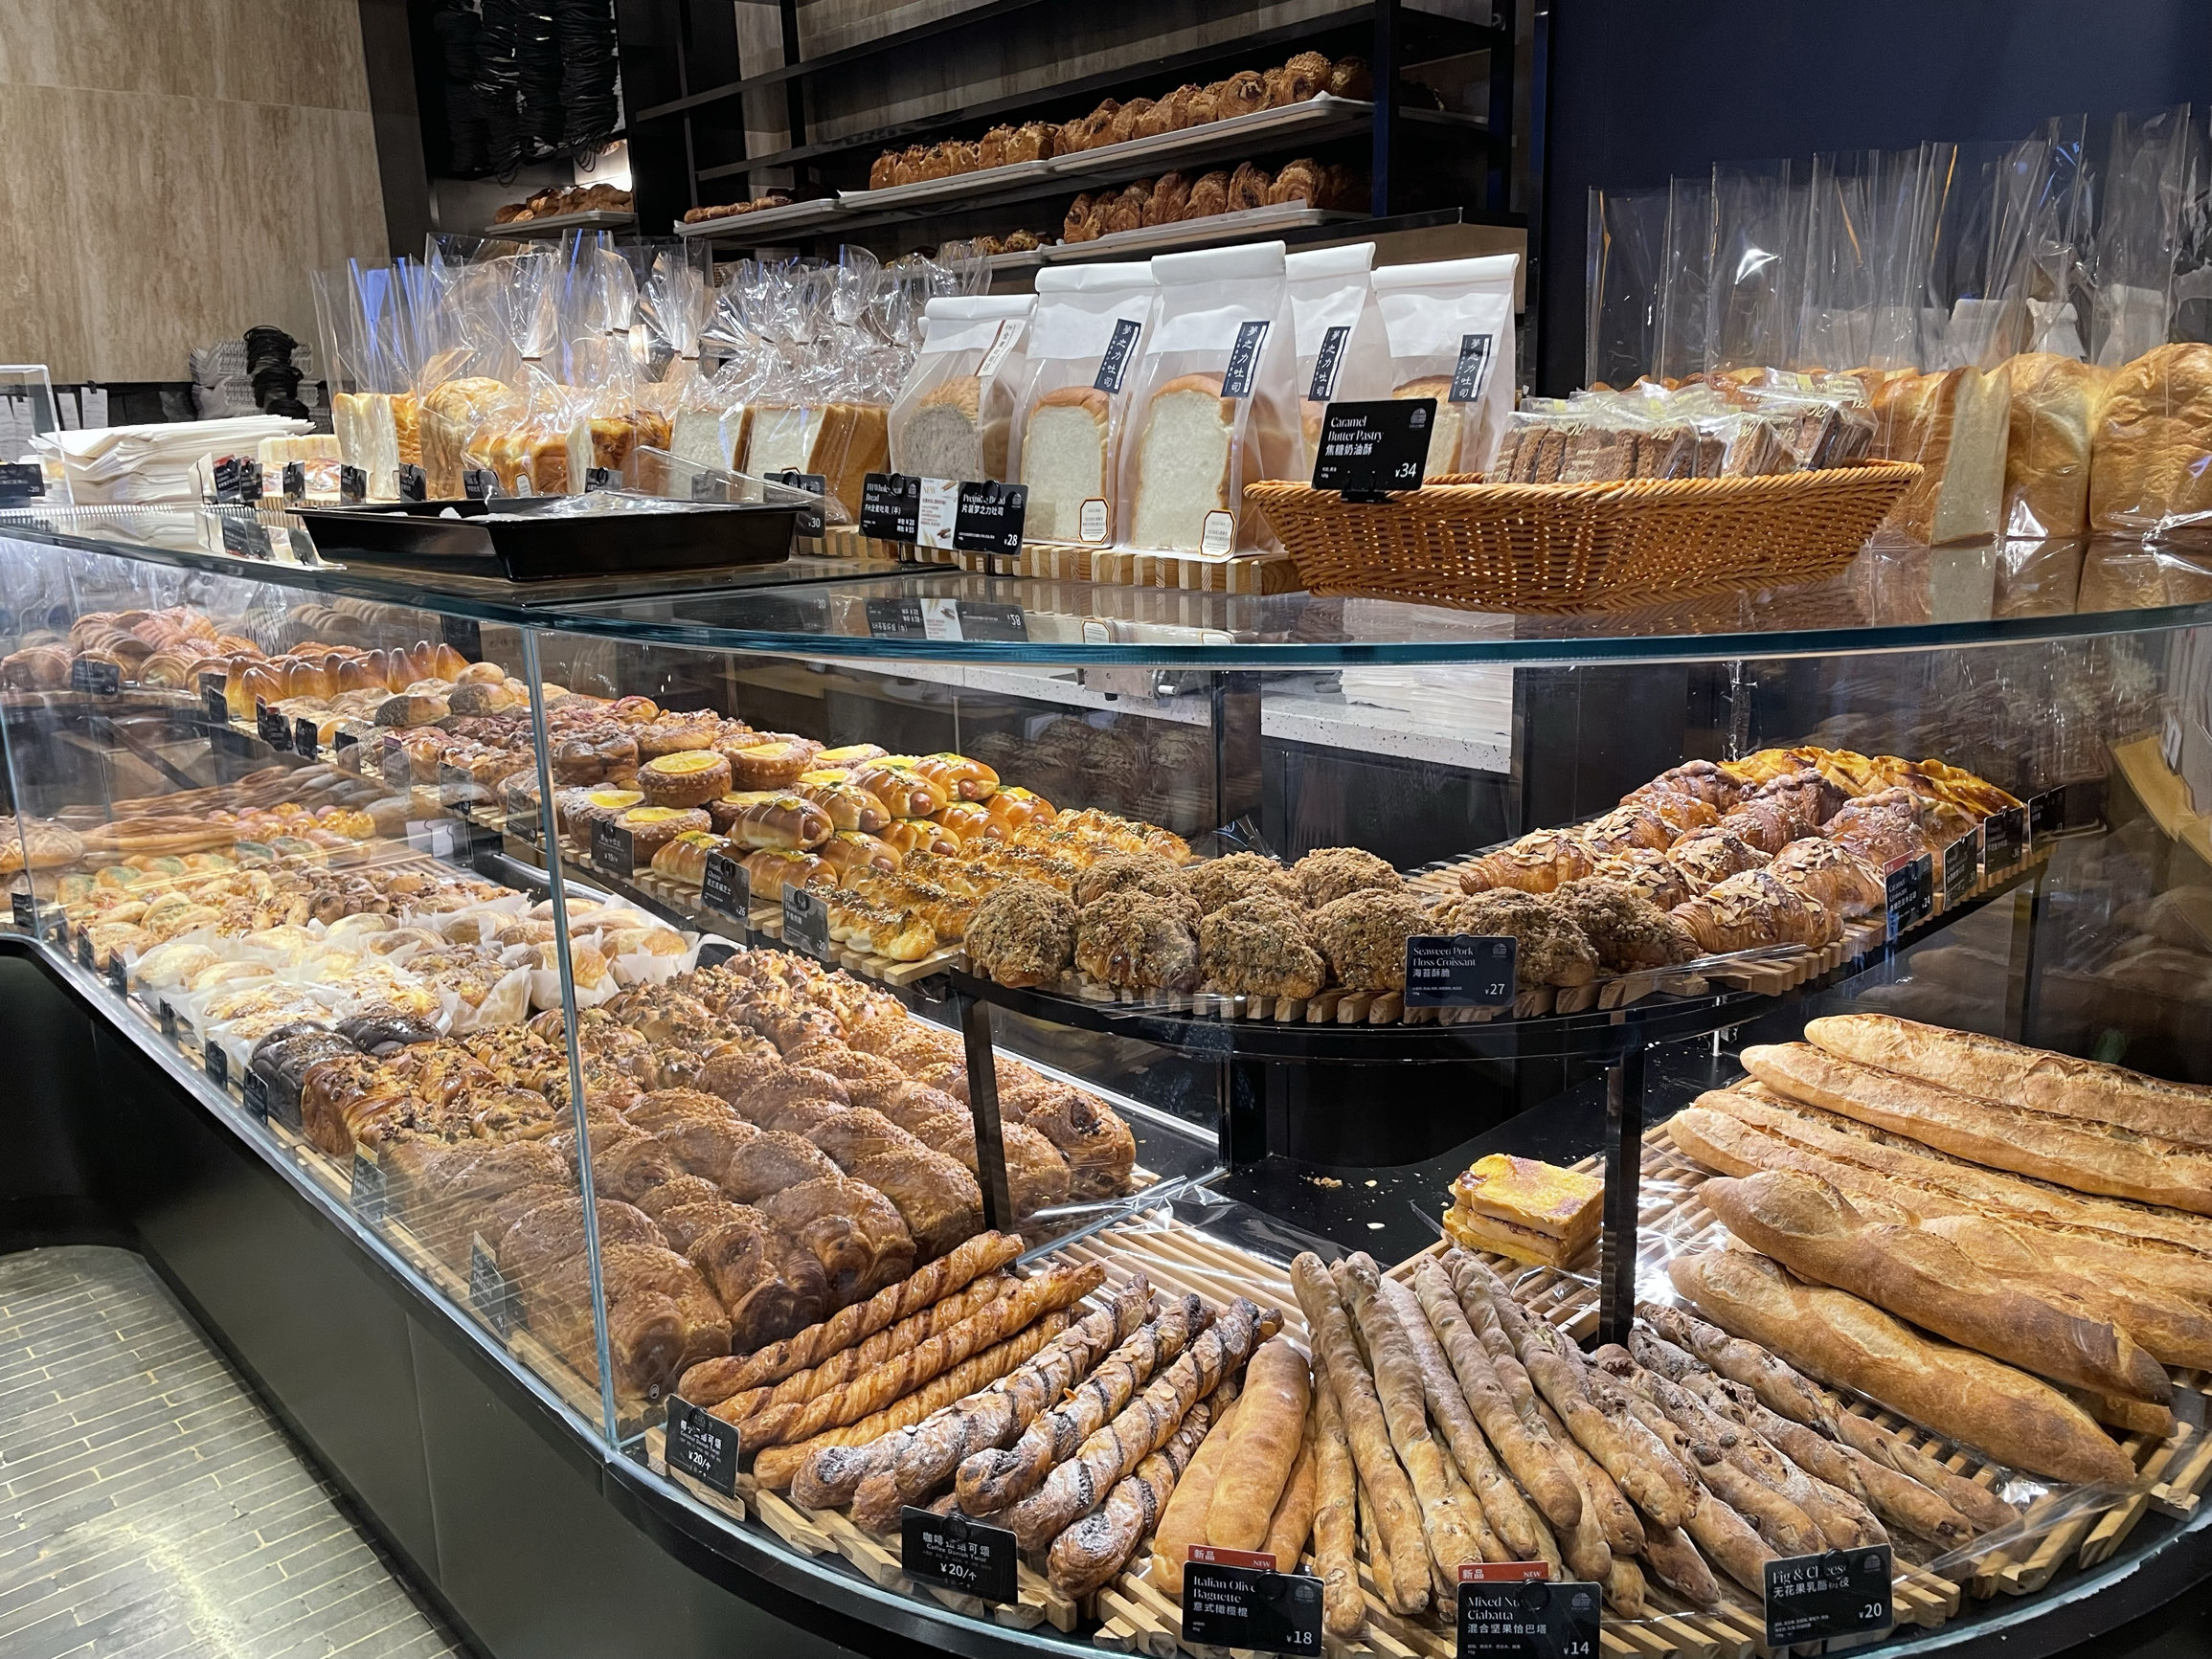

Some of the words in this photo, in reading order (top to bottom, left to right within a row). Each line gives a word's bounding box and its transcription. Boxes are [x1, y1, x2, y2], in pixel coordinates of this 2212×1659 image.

[1330, 415, 1367, 428] Caramel
[1328, 431, 1355, 441] Butter
[1356, 430, 1384, 443] Pastry
[1325, 443, 1372, 456] 焦糖奶油酥
[1395, 462, 1417, 478] ¥34
[1004, 534, 1018, 547] ¥28
[1413, 947, 1451, 955] Seaweed
[1453, 947, 1474, 956] Pork
[1413, 958, 1434, 967] Floss
[1436, 957, 1476, 967] Croissant
[1485, 983, 1505, 996] ¥27
[926, 1543, 946, 1553] Coffee
[970, 1554, 987, 1563] Twist
[1194, 1549, 1215, 1561] 新品
[1462, 1569, 1484, 1580] 新品
[1772, 1571, 1791, 1585] Fig
[1793, 1567, 1803, 1581] &
[1193, 1576, 1227, 1589] Italian
[1229, 1580, 1256, 1593] Olive
[1193, 1588, 1242, 1603] Baguette
[1467, 1596, 1501, 1607] Mixed
[1193, 1602, 1248, 1618] 意式橄榄棍
[1467, 1610, 1514, 1621] Ciabatta
[1859, 1603, 1883, 1619] ¥20
[1467, 1624, 1546, 1635] 混合坚果恰巴塔
[1286, 1630, 1313, 1645] ¥18
[1563, 1642, 1590, 1655] ¥14
